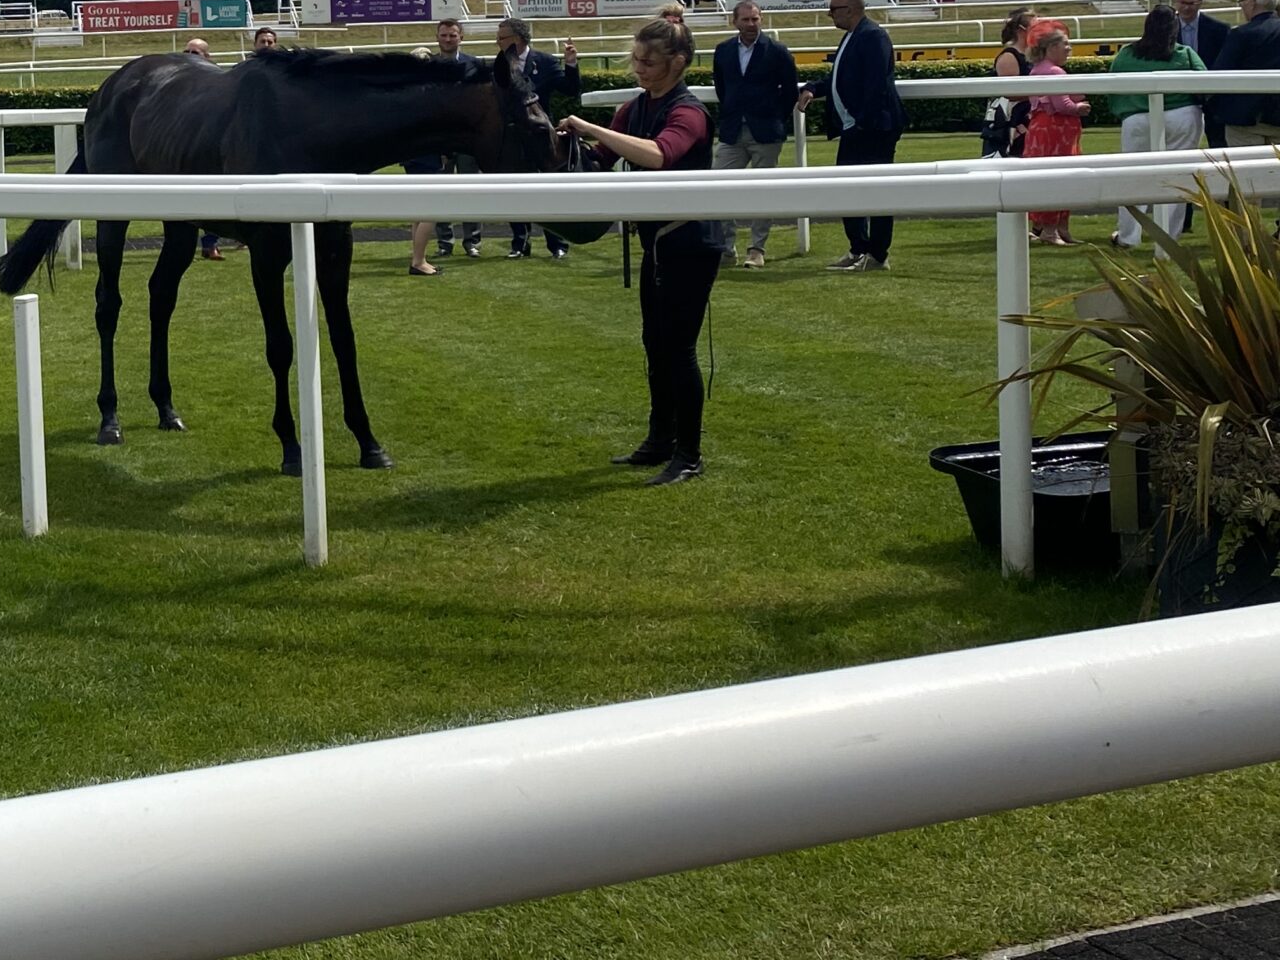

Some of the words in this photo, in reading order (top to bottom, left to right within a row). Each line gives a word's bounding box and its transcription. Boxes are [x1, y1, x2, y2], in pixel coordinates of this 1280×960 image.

[87, 5, 104, 16] Go
[105, 7, 132, 16] on...
[570, 1, 596, 15] £59
[88, 16, 121, 28] TREAT
[123, 14, 174, 27] YOURSELF
